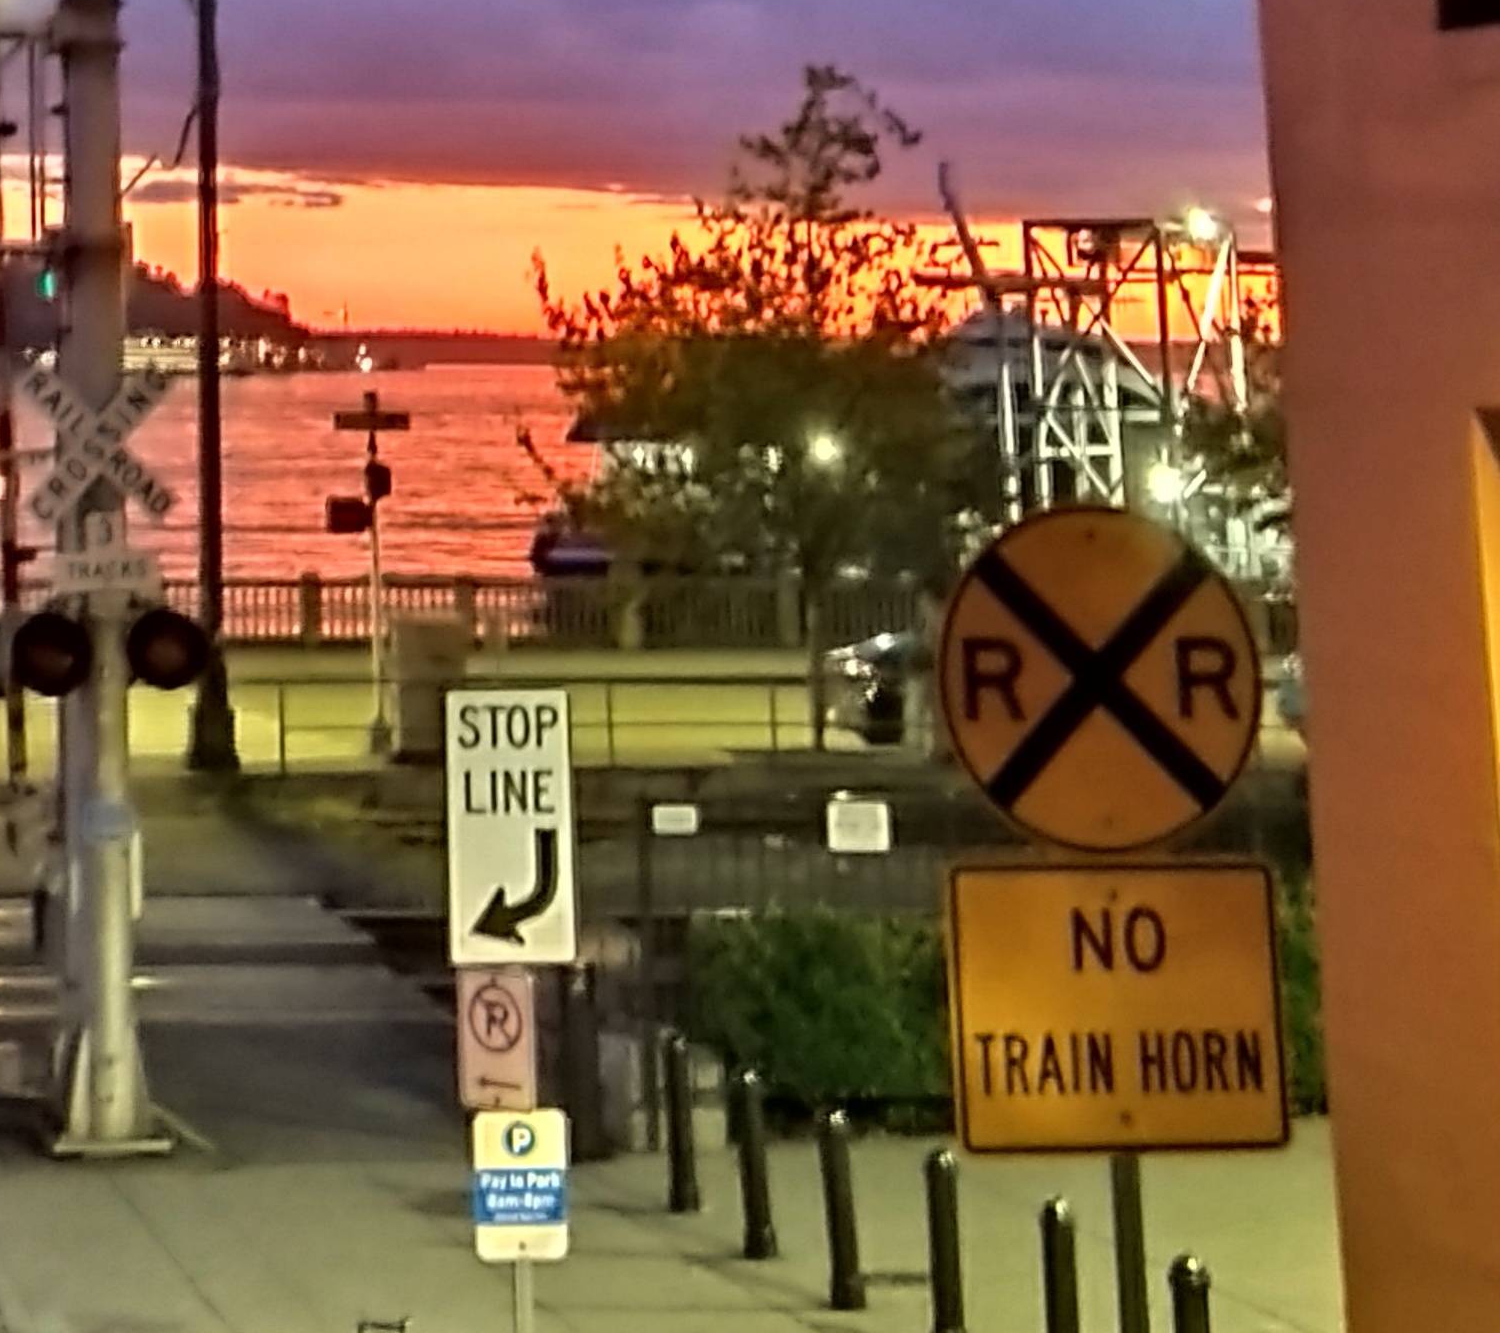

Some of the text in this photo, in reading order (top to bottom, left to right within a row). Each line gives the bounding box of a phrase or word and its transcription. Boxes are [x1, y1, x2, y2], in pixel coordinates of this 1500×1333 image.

[31, 365, 167, 519] CROSSING
[458, 704, 559, 749] STOP
[464, 770, 555, 814] LINE
[1071, 906, 1166, 973] NO
[975, 1030, 1265, 1097] TRAIN HORN
[480, 1173, 507, 1190] Pay
[527, 1171, 560, 1189] Park
